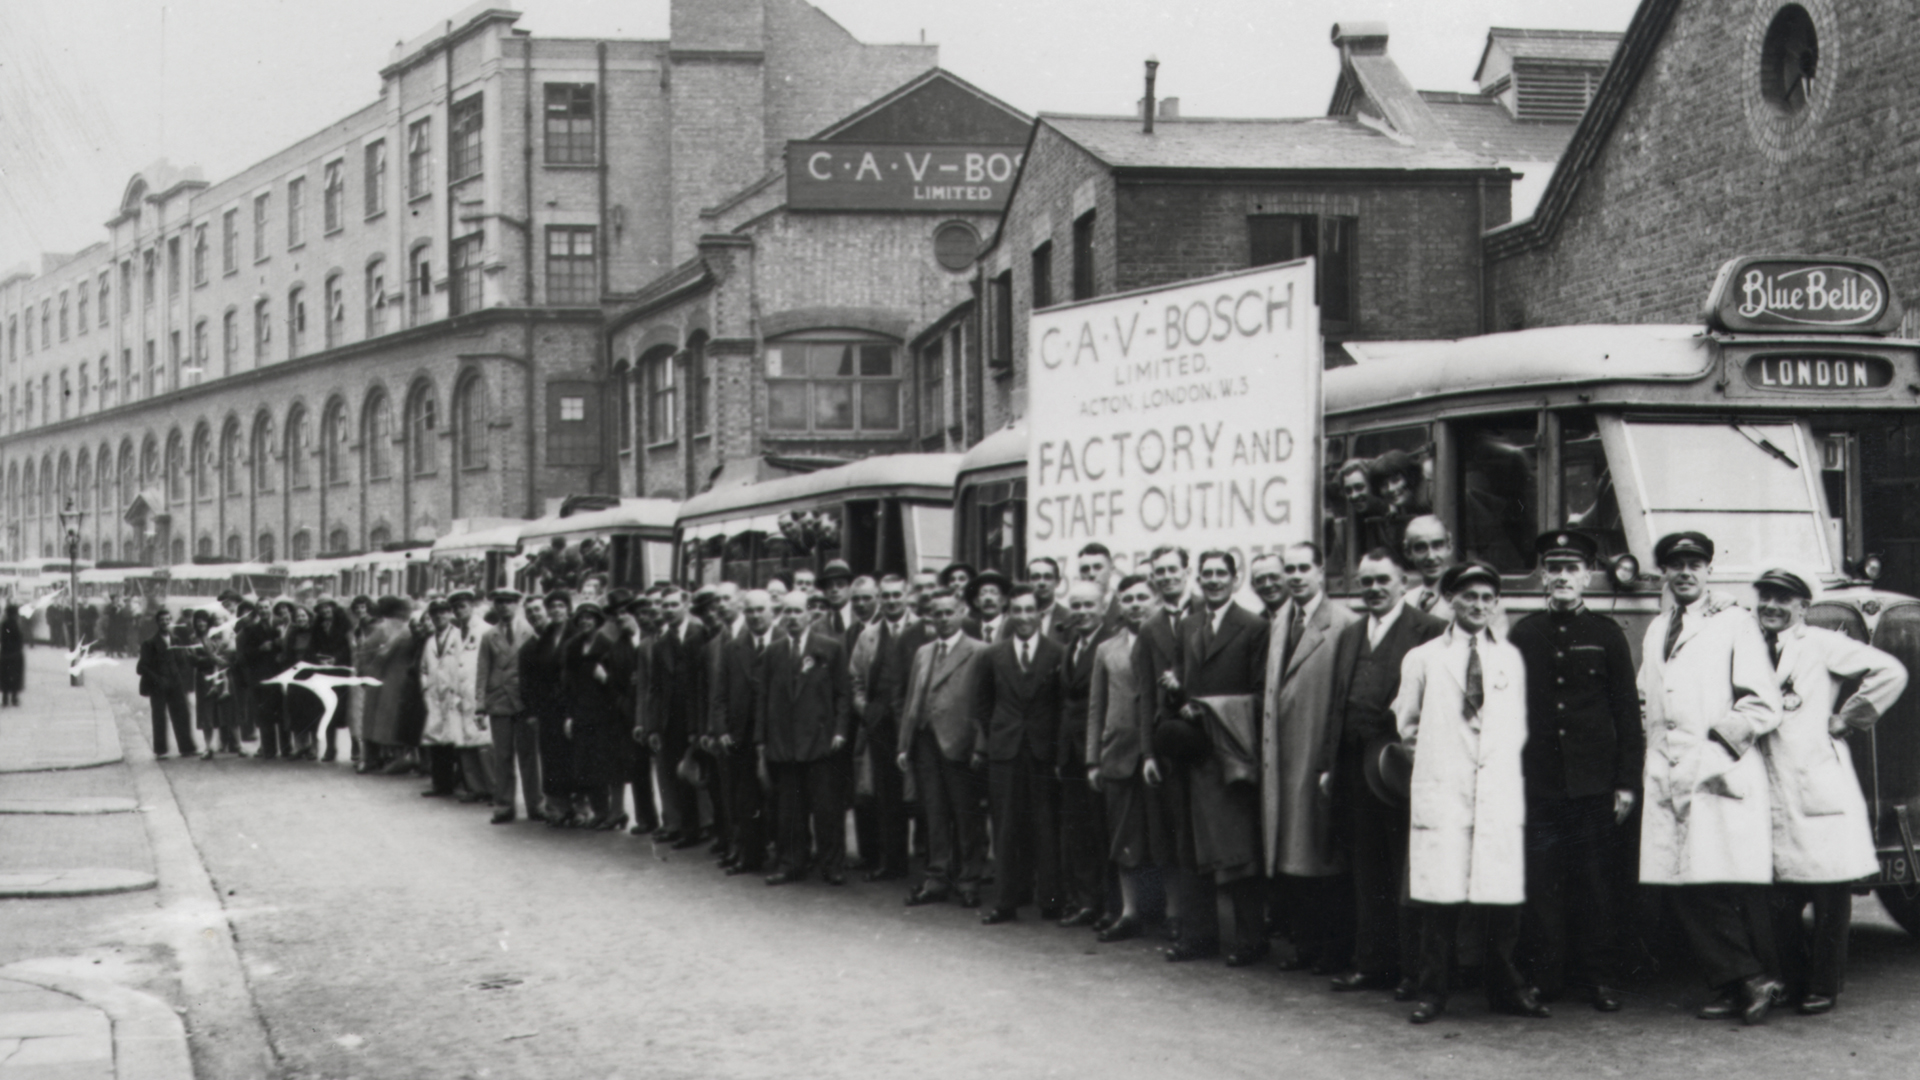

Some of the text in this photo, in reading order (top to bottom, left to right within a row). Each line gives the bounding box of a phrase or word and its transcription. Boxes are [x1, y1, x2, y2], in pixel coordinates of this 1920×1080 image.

[914, 186, 992, 200] LIMITED
[1738, 269, 1875, 318] Blue Belle
[1761, 359, 1868, 387] LONDON
[1039, 421, 1294, 486] FACTORY AND
[1035, 476, 1291, 540] STAFF OUTING
